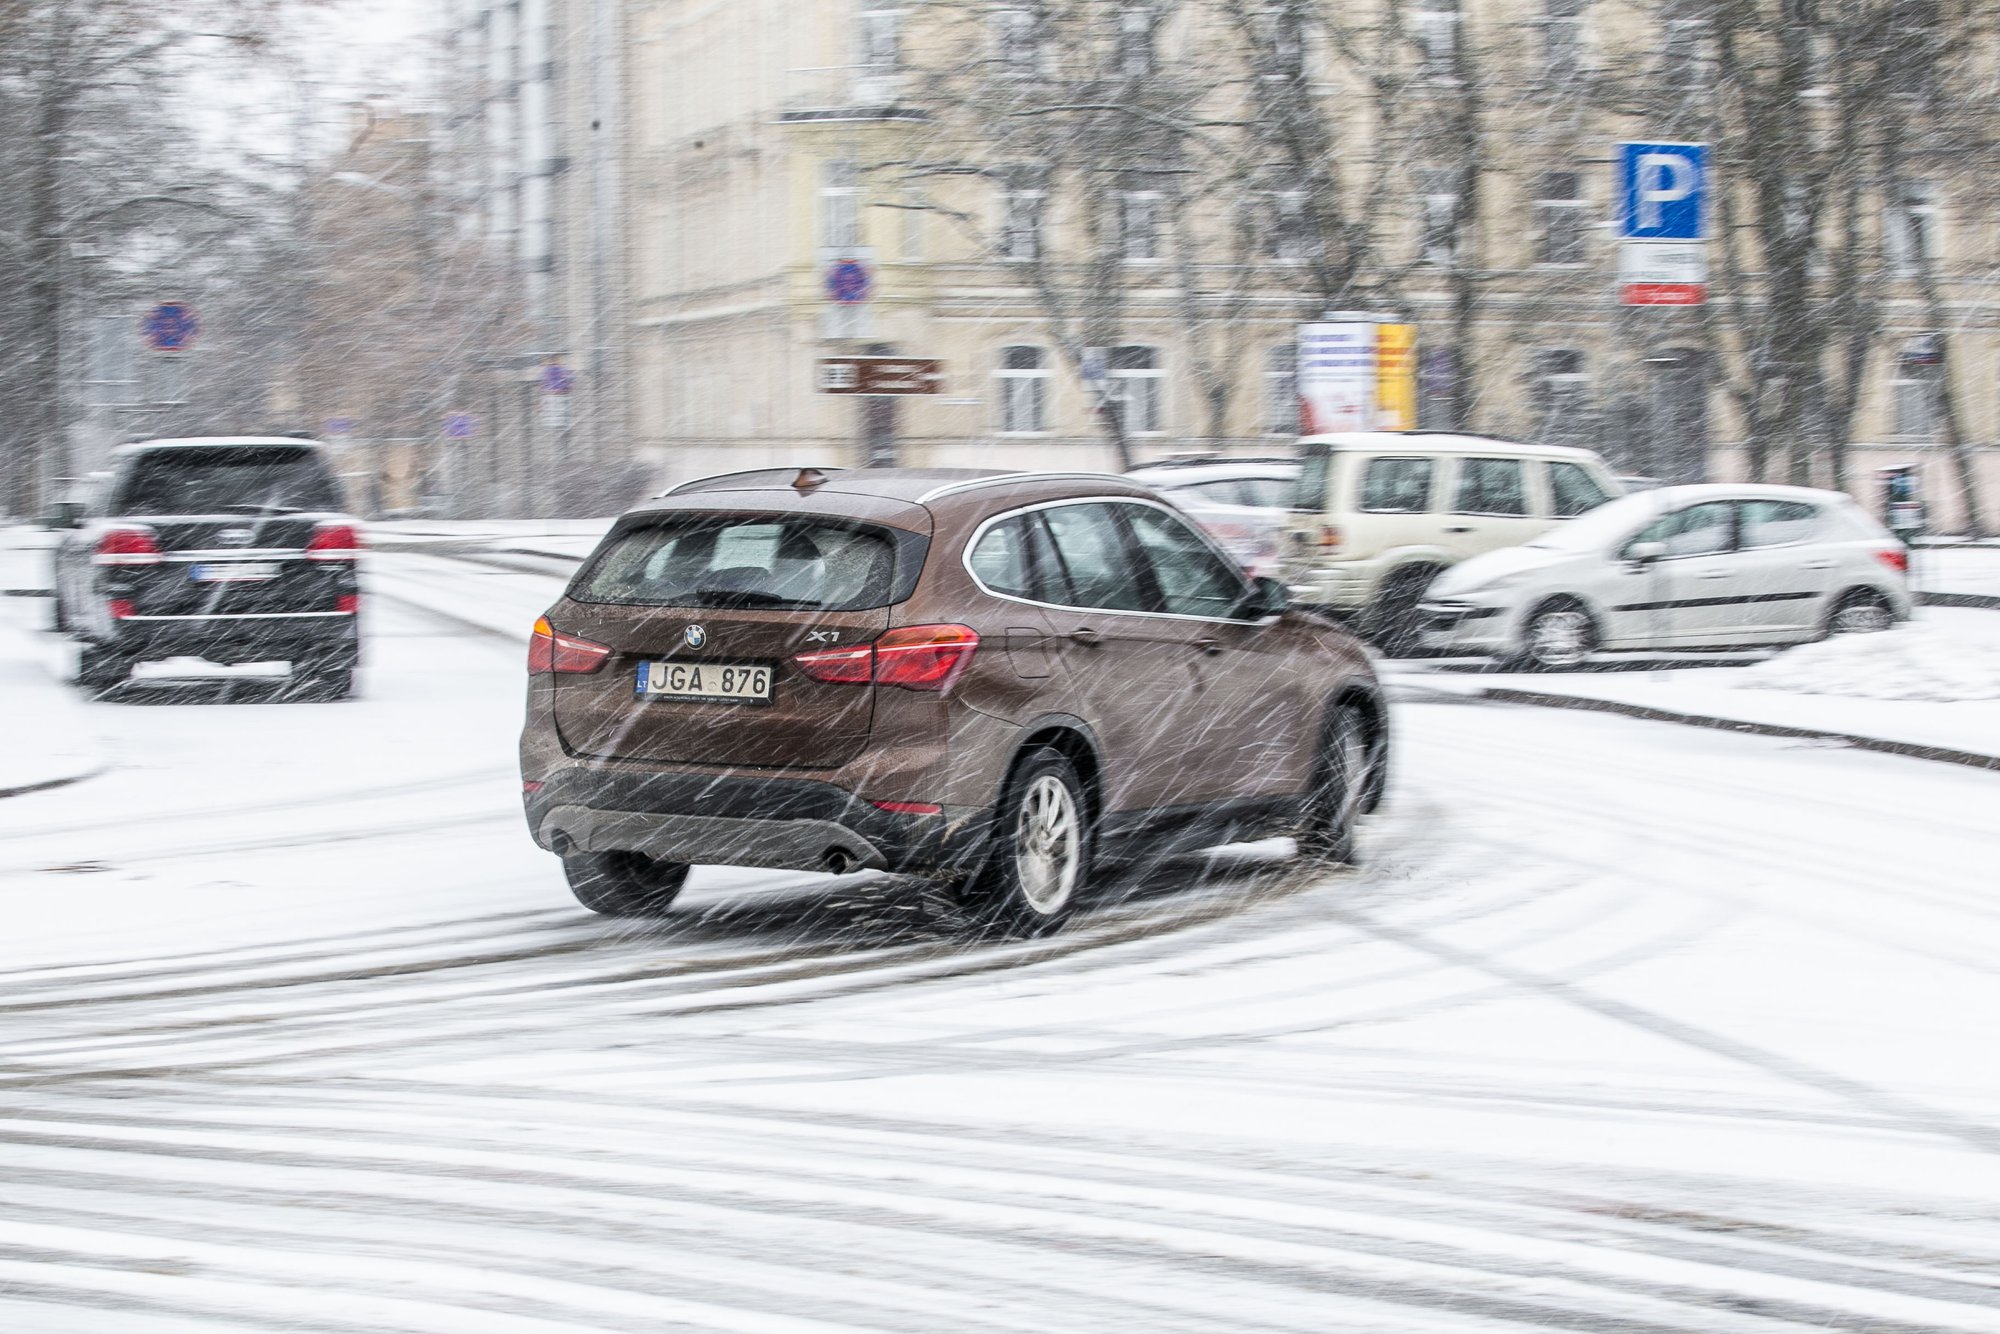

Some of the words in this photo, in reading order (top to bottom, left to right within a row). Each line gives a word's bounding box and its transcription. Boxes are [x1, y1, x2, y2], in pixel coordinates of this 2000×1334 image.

[1635, 153, 1700, 228] P
[806, 631, 840, 642] X1
[637, 680, 648, 688] LT
[652, 665, 703, 692] JGA
[721, 668, 767, 695] 876
